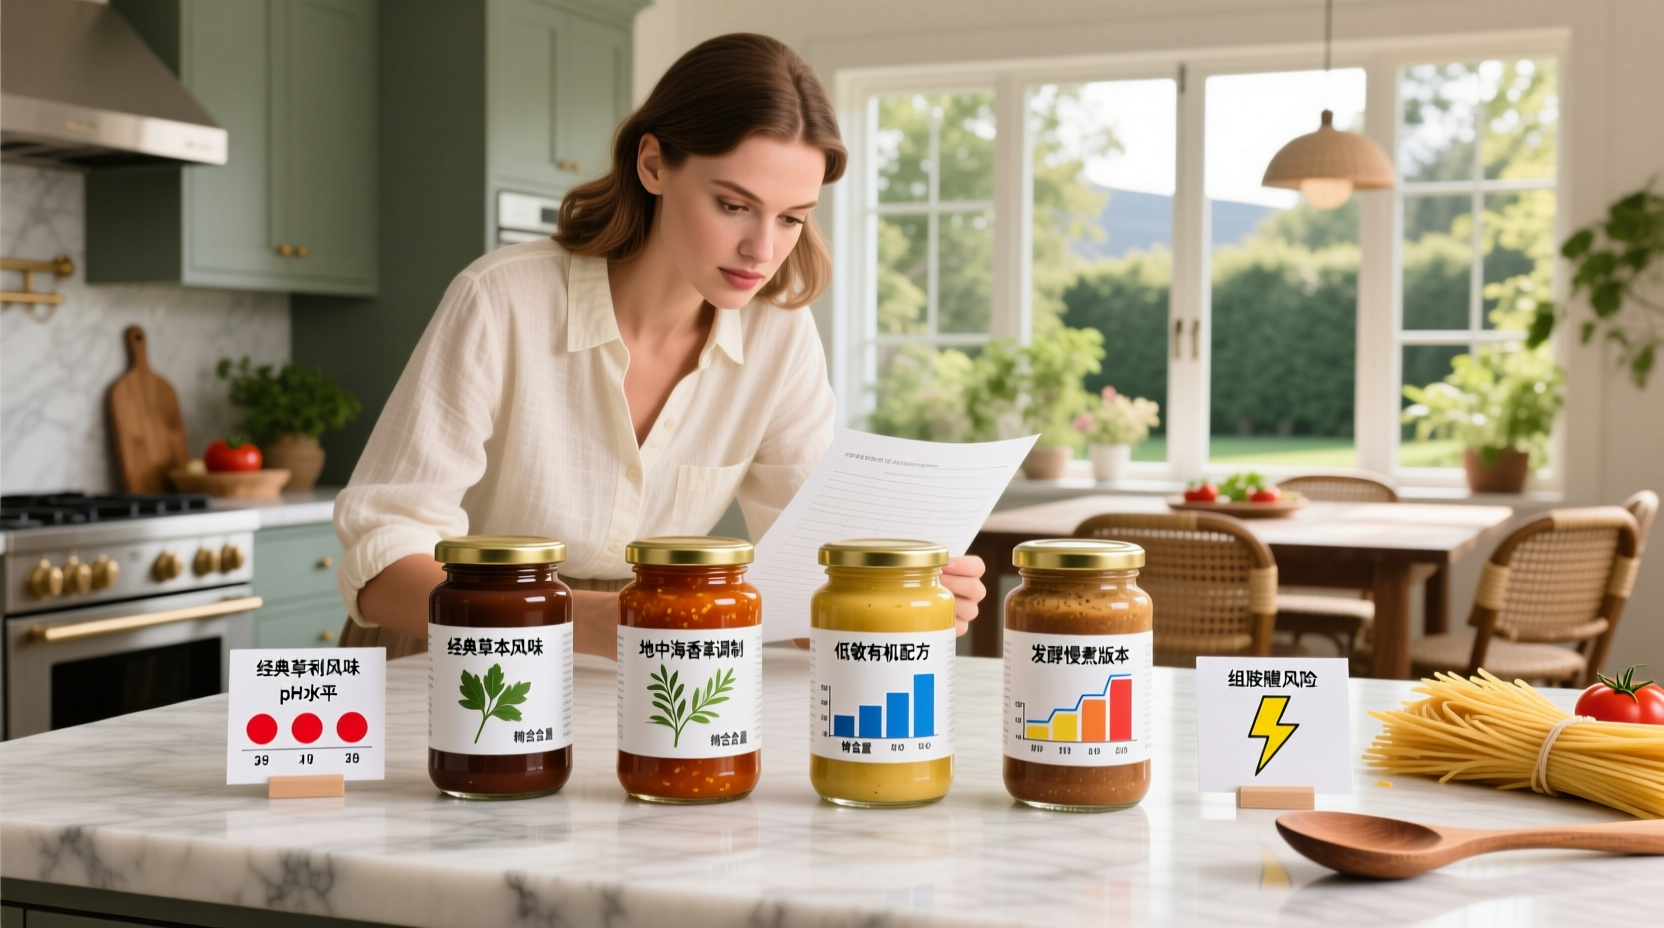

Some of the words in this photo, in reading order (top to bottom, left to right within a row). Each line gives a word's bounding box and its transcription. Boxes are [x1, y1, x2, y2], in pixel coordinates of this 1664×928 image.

[447, 636, 544, 657] 经典草本风味
[279, 684, 338, 705] pH水平
